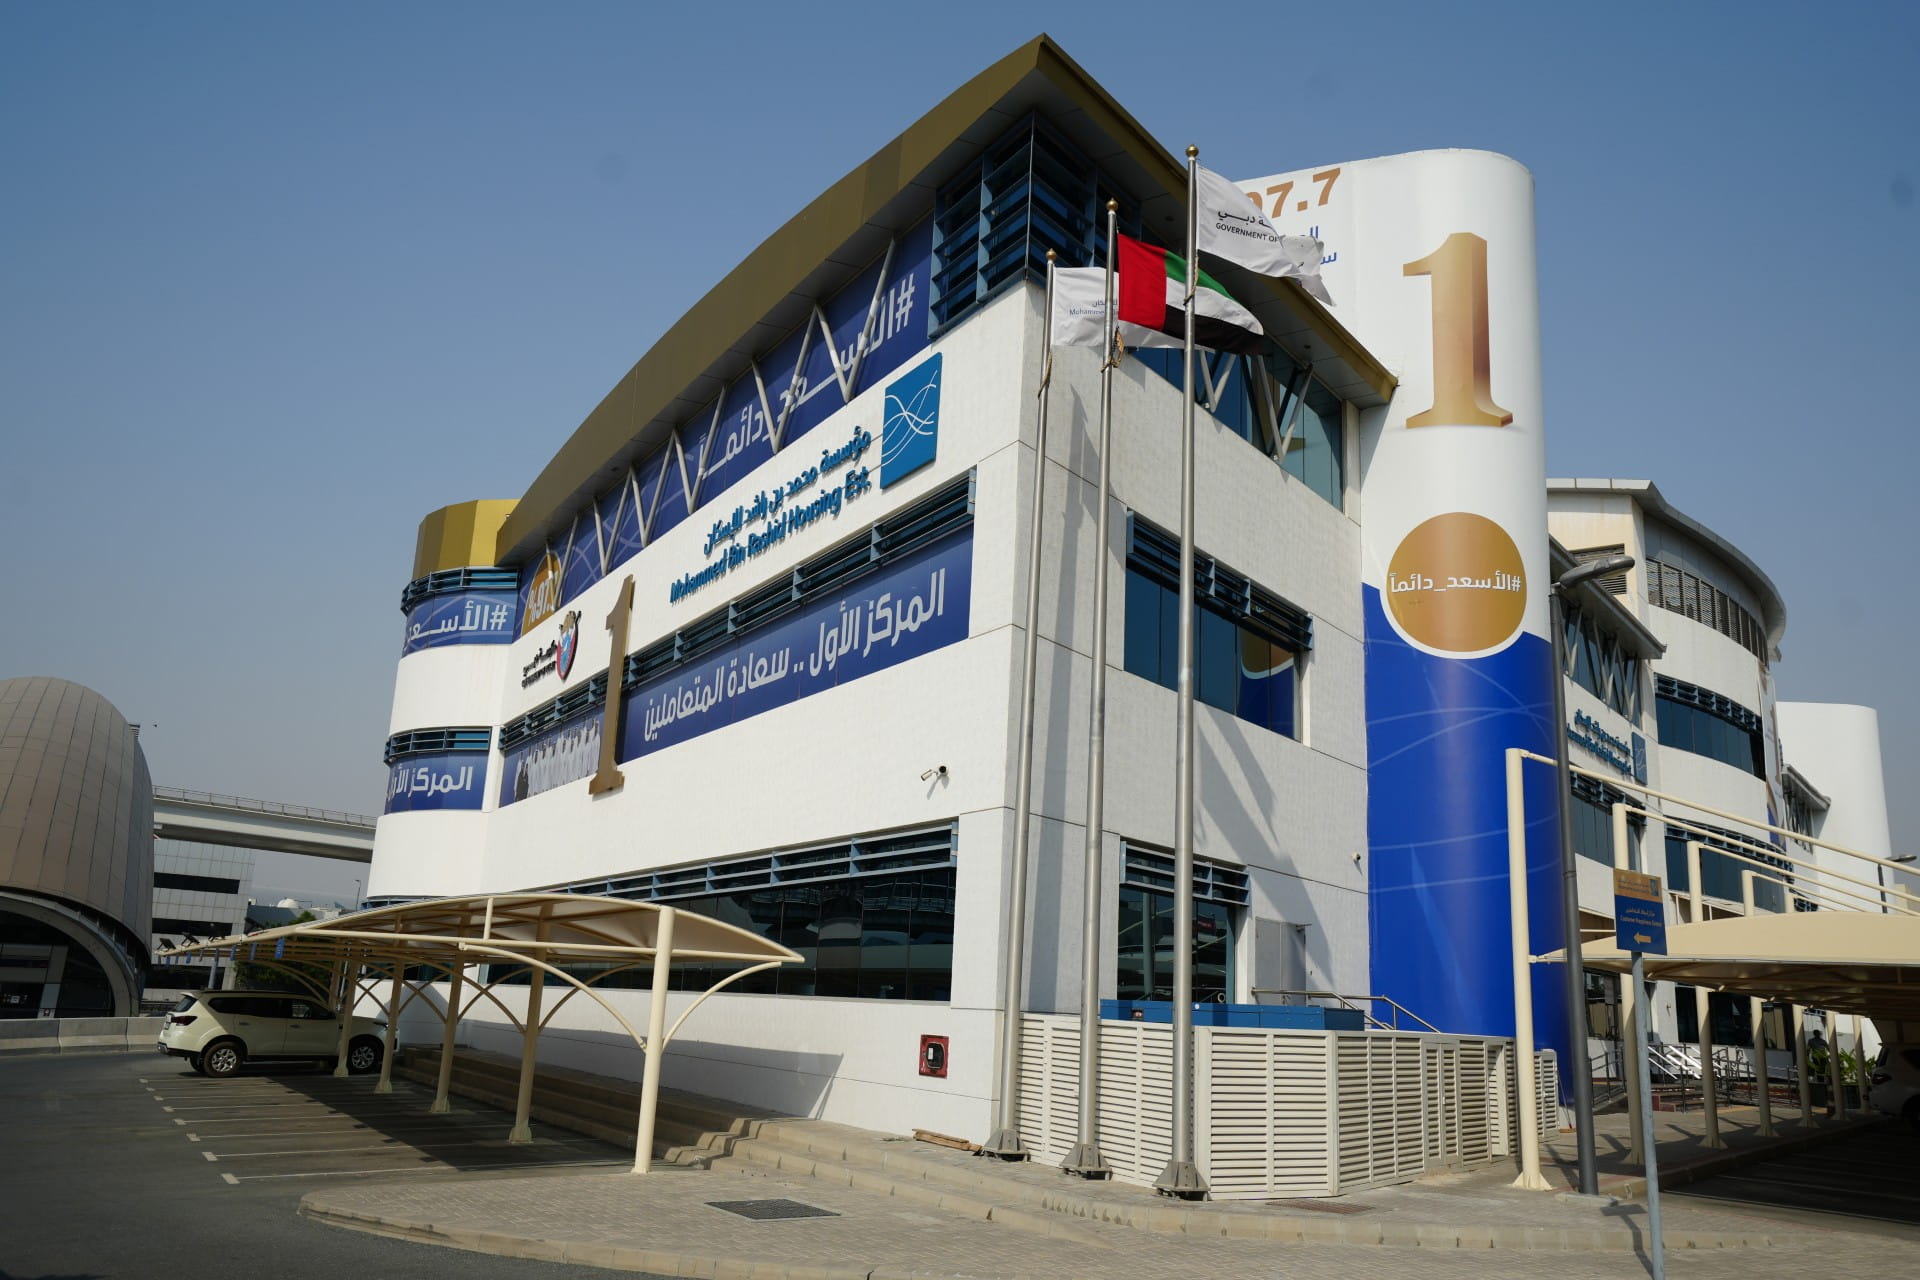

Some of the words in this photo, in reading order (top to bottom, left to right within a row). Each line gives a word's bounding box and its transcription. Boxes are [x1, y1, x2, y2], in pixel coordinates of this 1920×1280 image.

[1215, 221, 1268, 242] GOVERNMENT
[1069, 308, 1106, 316] Mohamme
[1402, 232, 1514, 430] 1
[820, 425, 872, 473] مؤسسة
[769, 486, 784, 514] بن
[786, 466, 819, 497] محمد
[743, 490, 768, 524] راشد
[670, 548, 728, 603] Mohammed
[728, 543, 746, 569] Bin
[747, 511, 787, 557] Rashid
[788, 486, 843, 534] Housing
[862, 567, 946, 657] المركز
[809, 600, 861, 677] الأول
[727, 647, 790, 699] سعادة
[643, 664, 725, 742] المتعاملين
[408, 766, 474, 799] المركز
